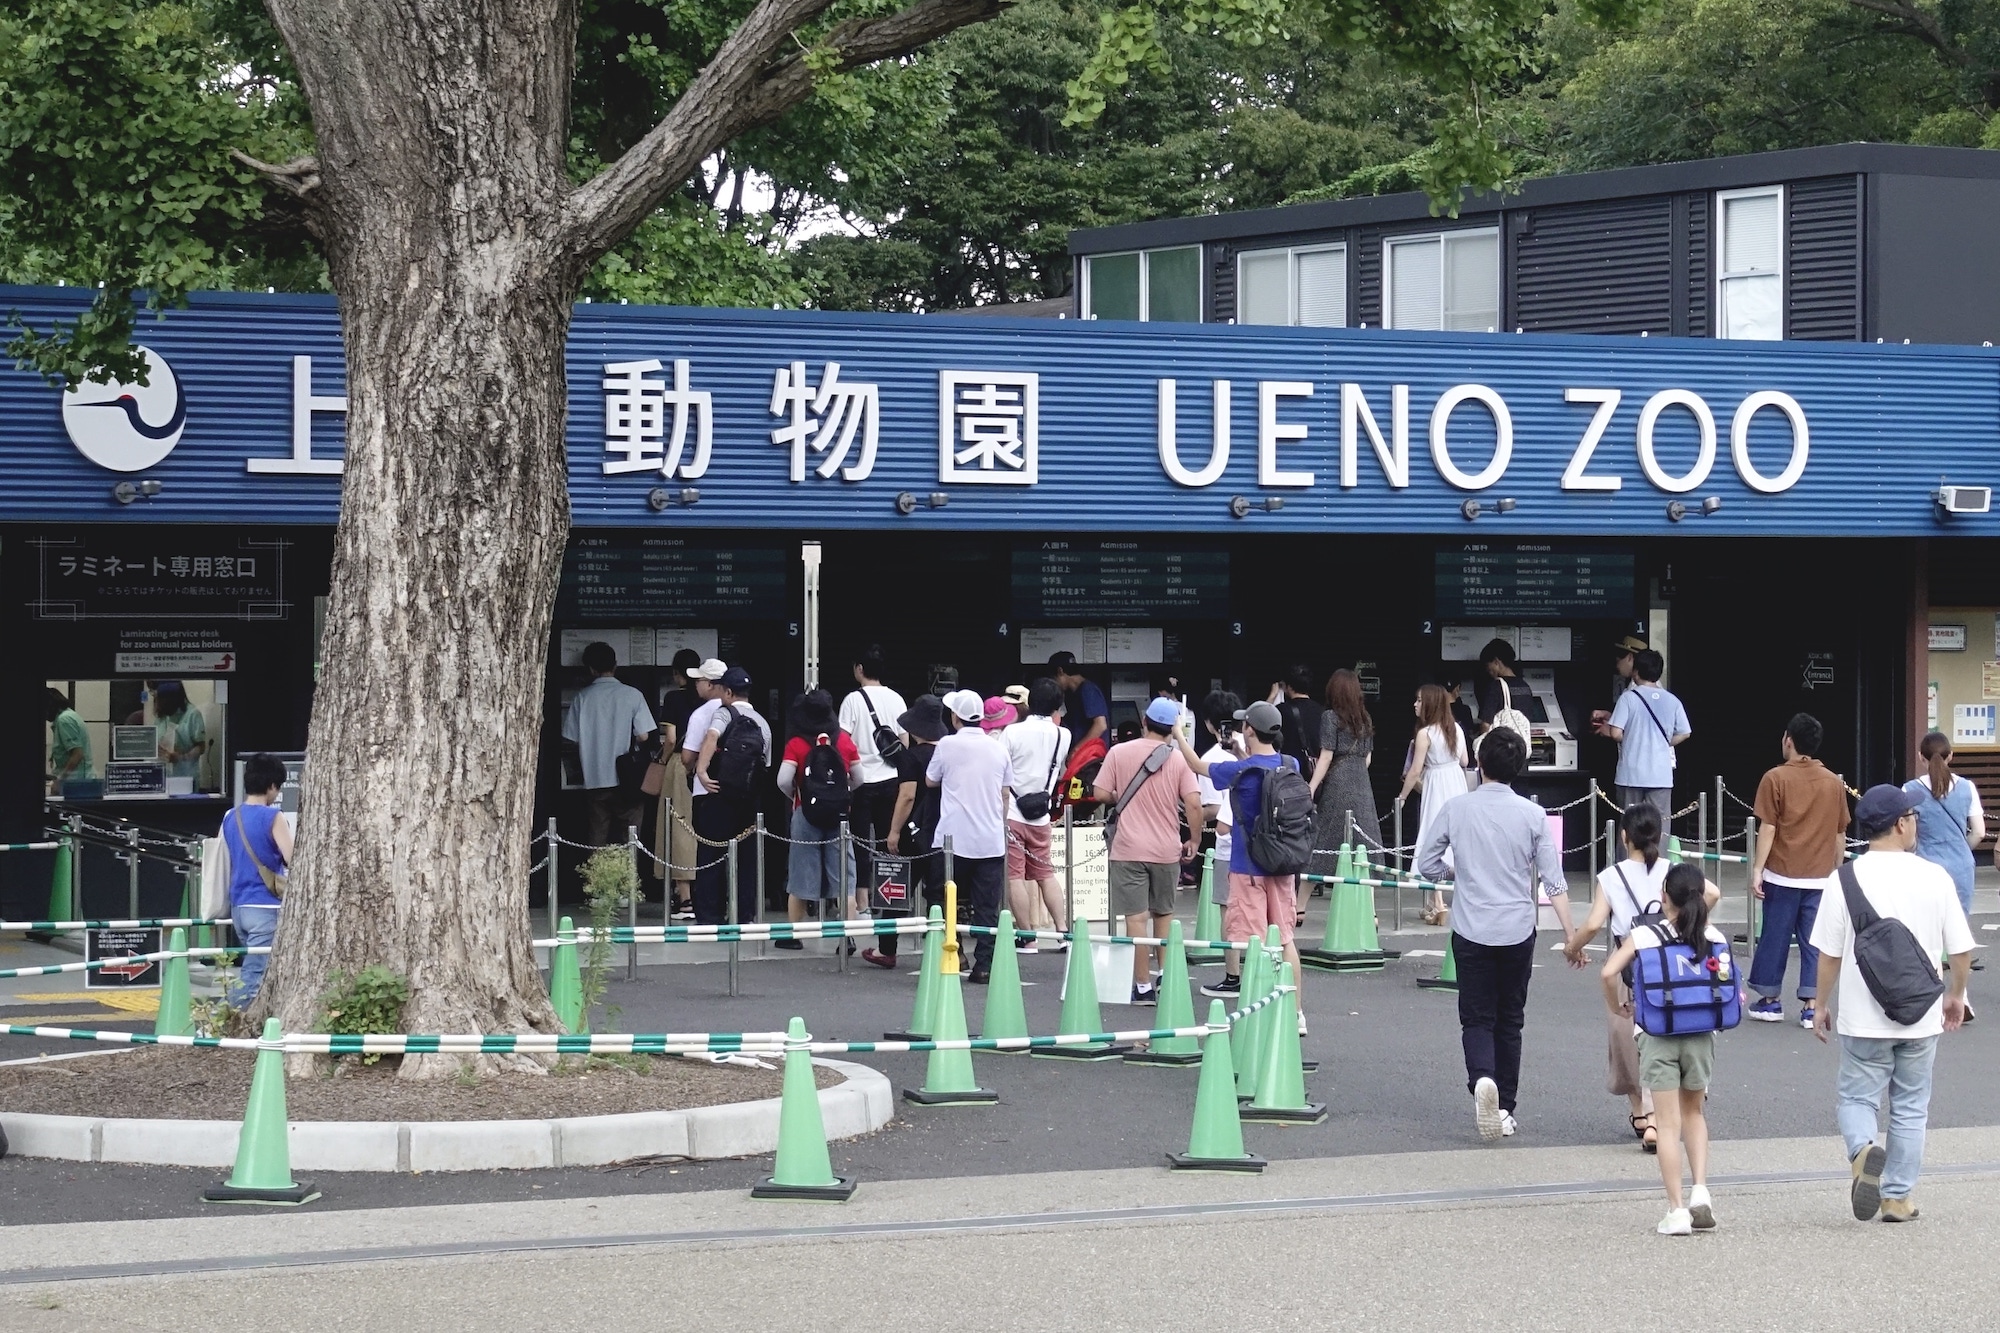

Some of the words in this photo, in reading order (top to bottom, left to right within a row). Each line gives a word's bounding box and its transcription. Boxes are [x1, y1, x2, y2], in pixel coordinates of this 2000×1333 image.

[247, 355, 1038, 485] 上動物園
[1157, 378, 1513, 490] UENO
[1560, 388, 1809, 492] ZOO
[59, 556, 256, 578] ラミネート専用窓口
[789, 623, 798, 636] 5
[999, 623, 1008, 636] 4
[1233, 623, 1242, 635] 3
[1423, 621, 1432, 634] 2
[1636, 621, 1644, 633] 1
[120, 629, 168, 639] Laminating
[169, 630, 199, 638] service
[200, 629, 220, 638] desk
[120, 640, 132, 648] for
[151, 640, 180, 648] annual
[181, 642, 200, 650] pass
[201, 640, 234, 648] holders
[1085, 833, 1106, 842] 16:00
[1085, 865, 1106, 873] 17:00
[1073, 878, 1094, 887] losing
